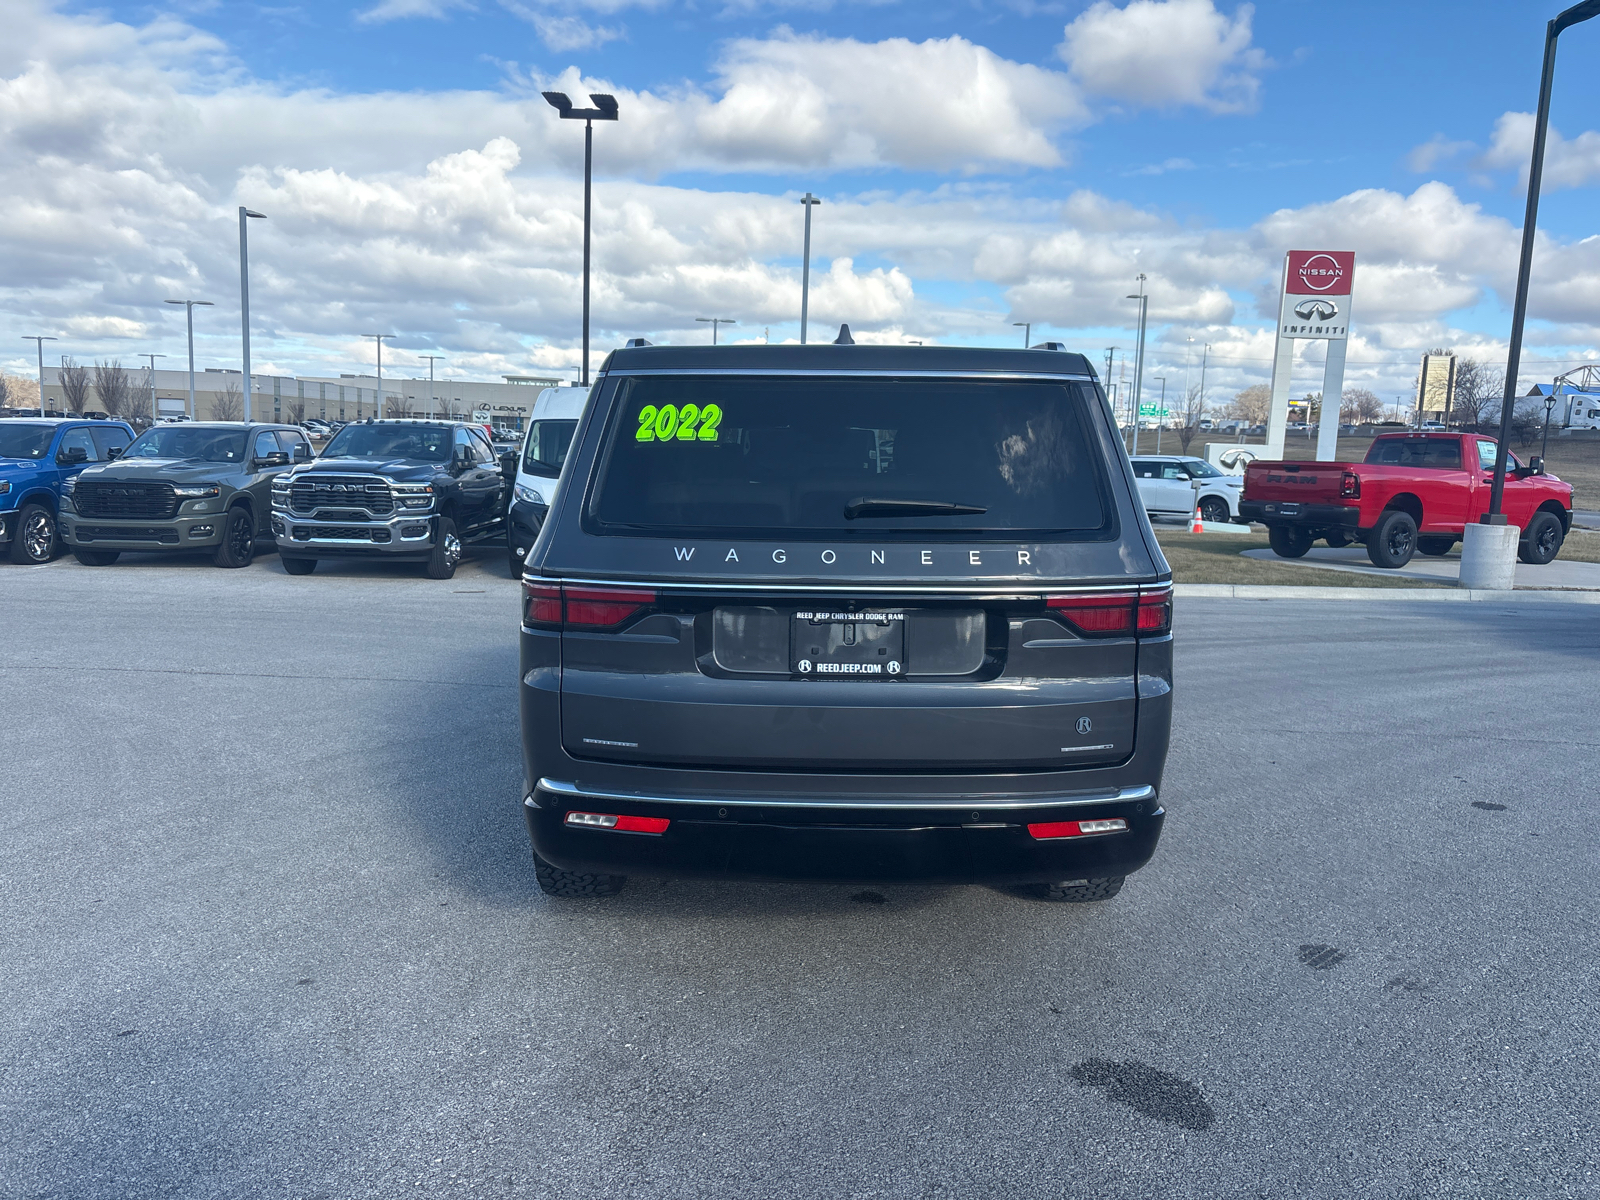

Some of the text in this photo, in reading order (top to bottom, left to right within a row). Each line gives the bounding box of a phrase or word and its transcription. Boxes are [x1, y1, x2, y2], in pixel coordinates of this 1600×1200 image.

[1299, 268, 1343, 276] NISSAN
[1283, 325, 1345, 335] INFINITI
[635, 403, 723, 442] 2022
[1266, 474, 1318, 485] RAM
[315, 484, 364, 492] RAM
[674, 547, 1031, 566] WAGONEER
[816, 612, 830, 620] JEEP
[831, 612, 864, 620] CHRYSLER
[816, 663, 882, 673] REEDJEEP.COM
